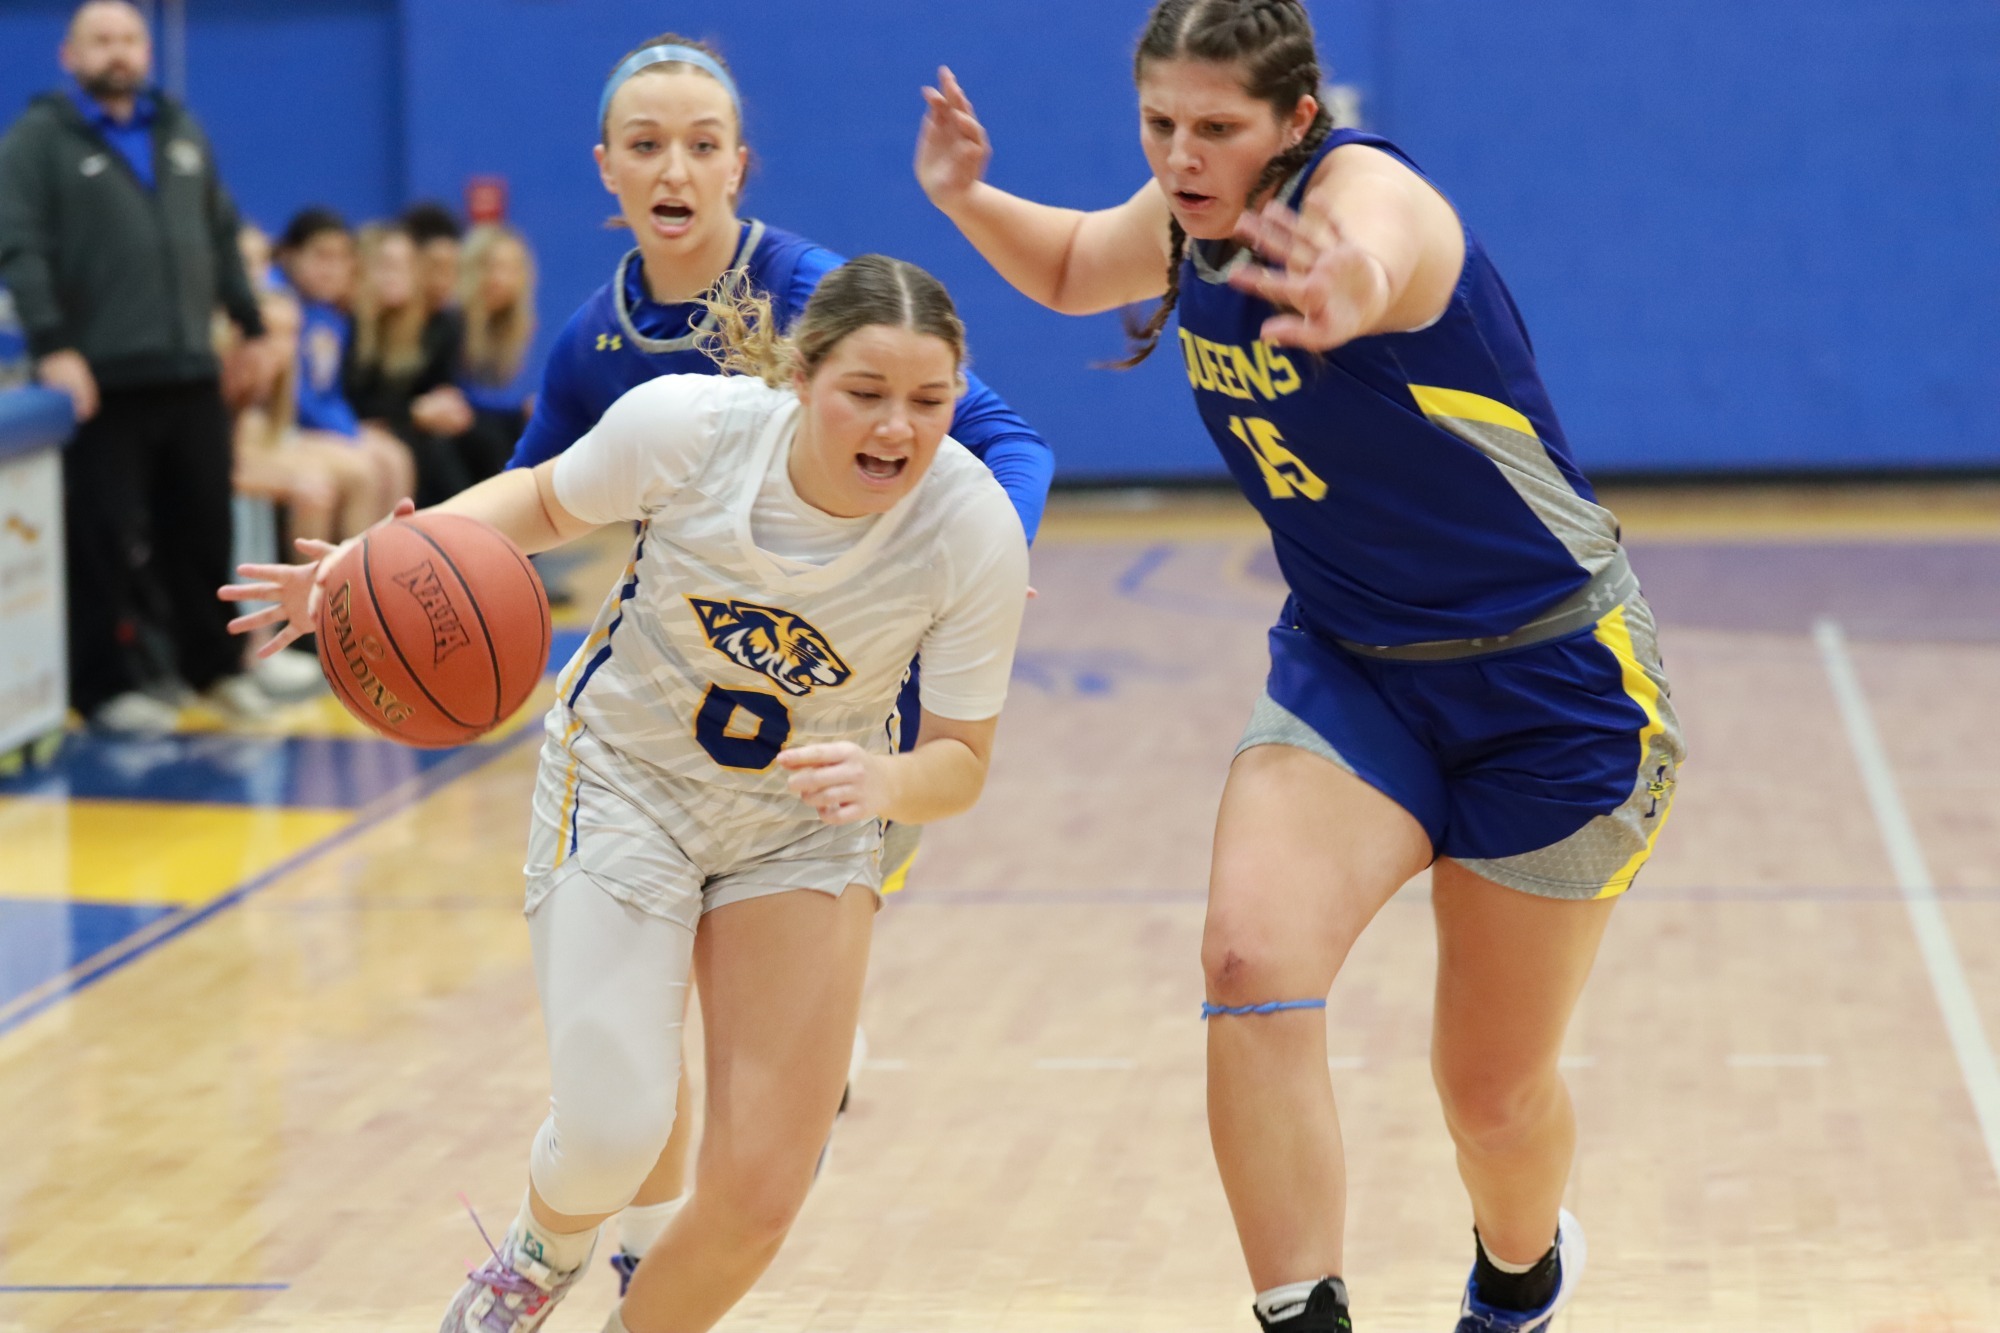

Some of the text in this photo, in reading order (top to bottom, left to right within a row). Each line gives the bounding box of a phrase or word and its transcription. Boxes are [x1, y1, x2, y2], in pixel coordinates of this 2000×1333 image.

[1228, 415, 1328, 501] 15
[328, 578, 415, 726] SPALDING
[692, 680, 793, 775] 0
